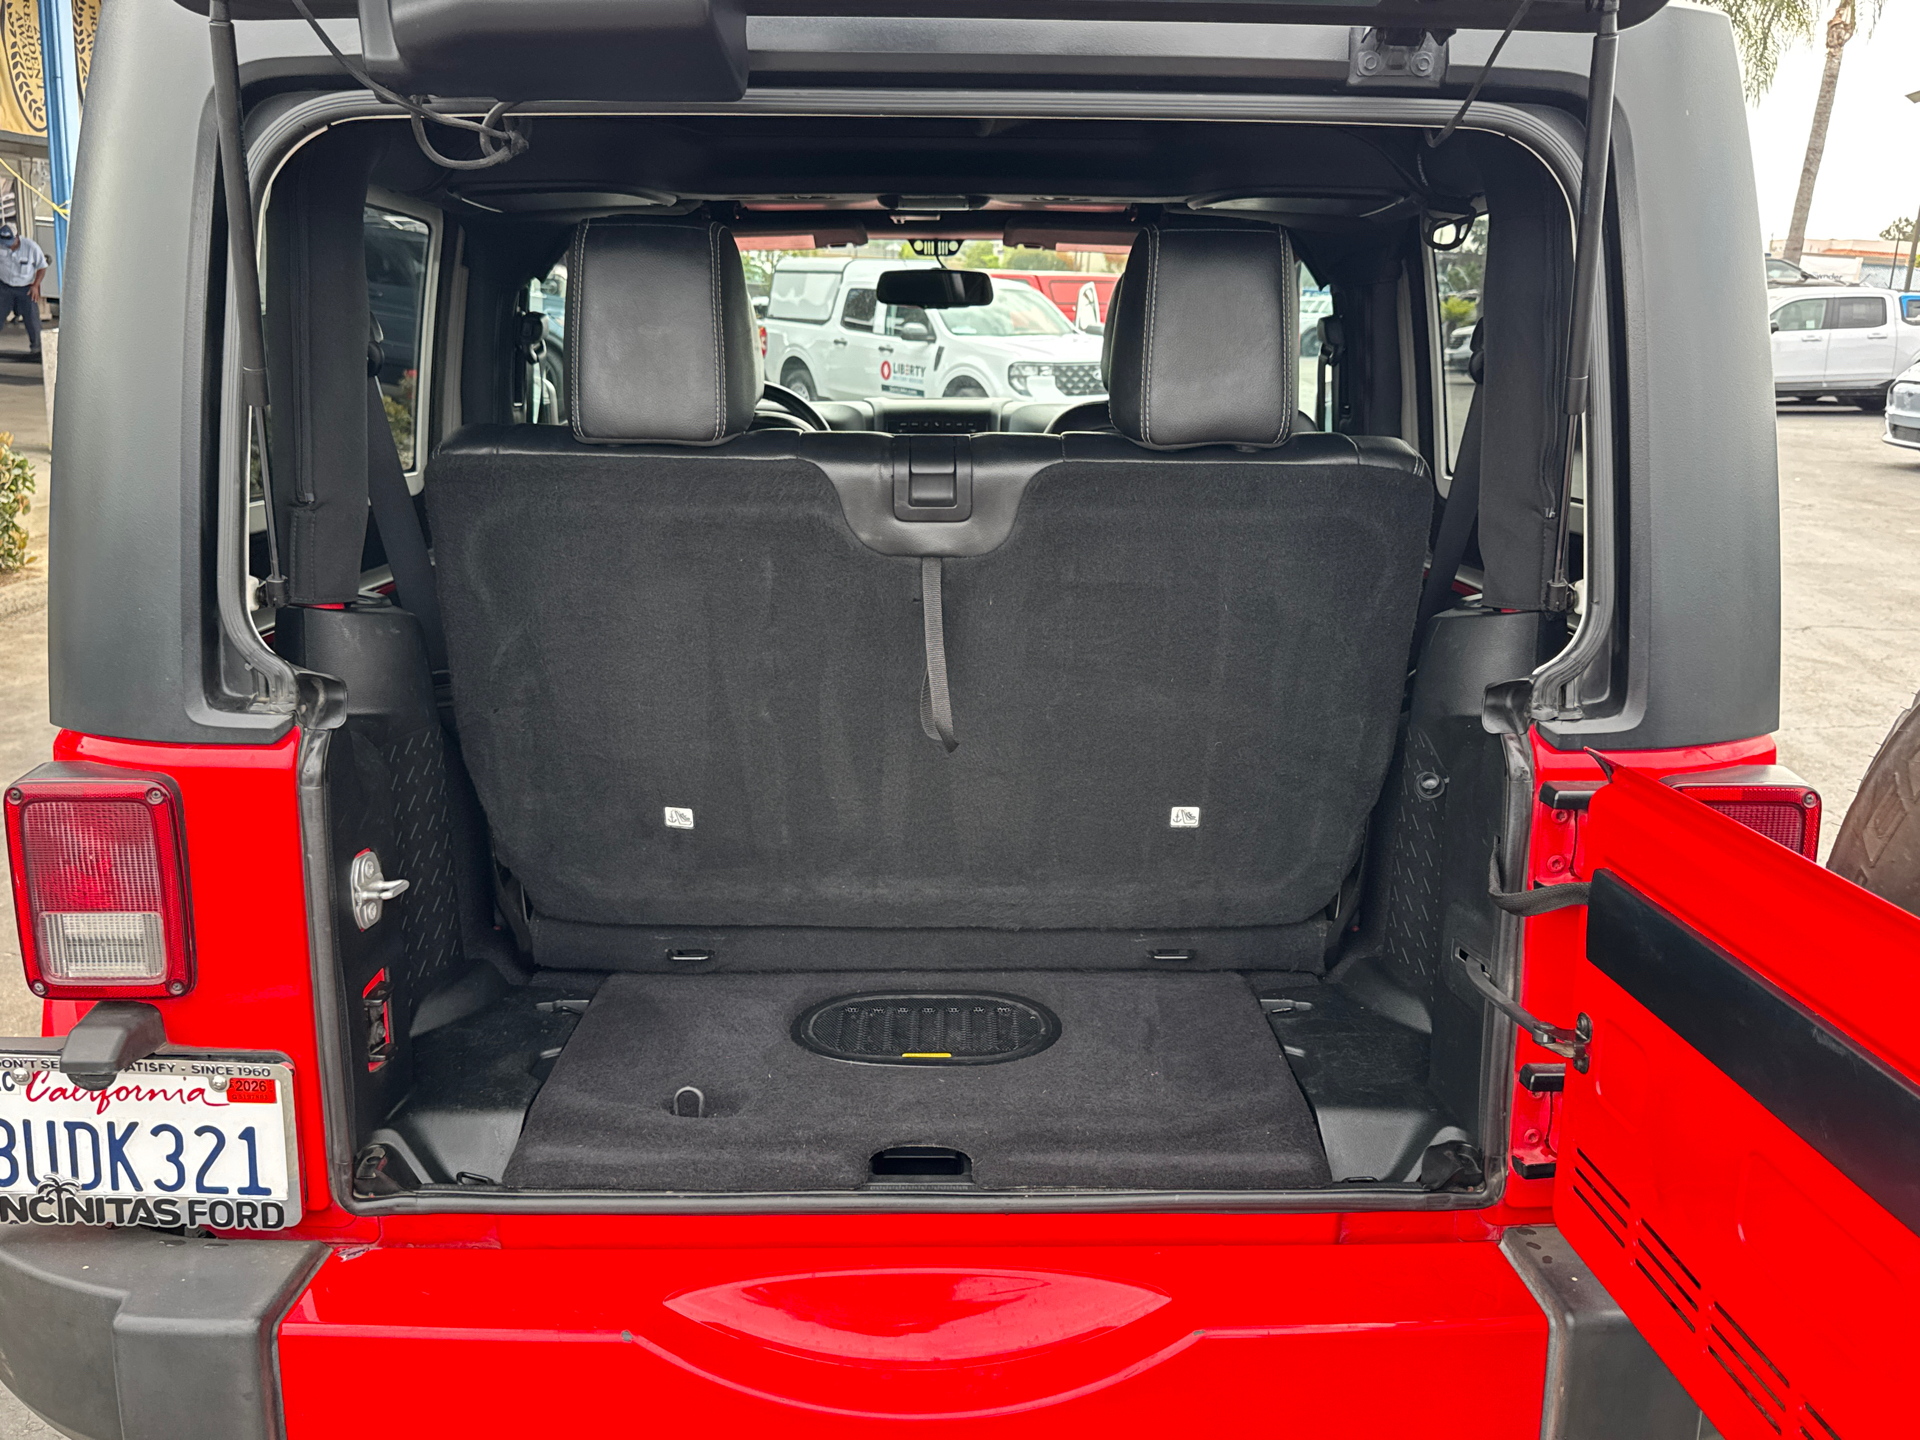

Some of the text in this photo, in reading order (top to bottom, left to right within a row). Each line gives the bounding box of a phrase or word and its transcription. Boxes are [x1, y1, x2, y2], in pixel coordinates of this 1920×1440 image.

[15, 10, 34, 79] AWARD
[893, 362, 926, 377] LIBERTY
[0, 1058, 37, 1069] ON'T
[124, 1061, 176, 1074] ATISFY
[191, 1063, 235, 1076] SINCE
[236, 1066, 271, 1078] 1960
[235, 1080, 268, 1092] 2026
[0, 1194, 286, 1230] NCINITAS FORD
